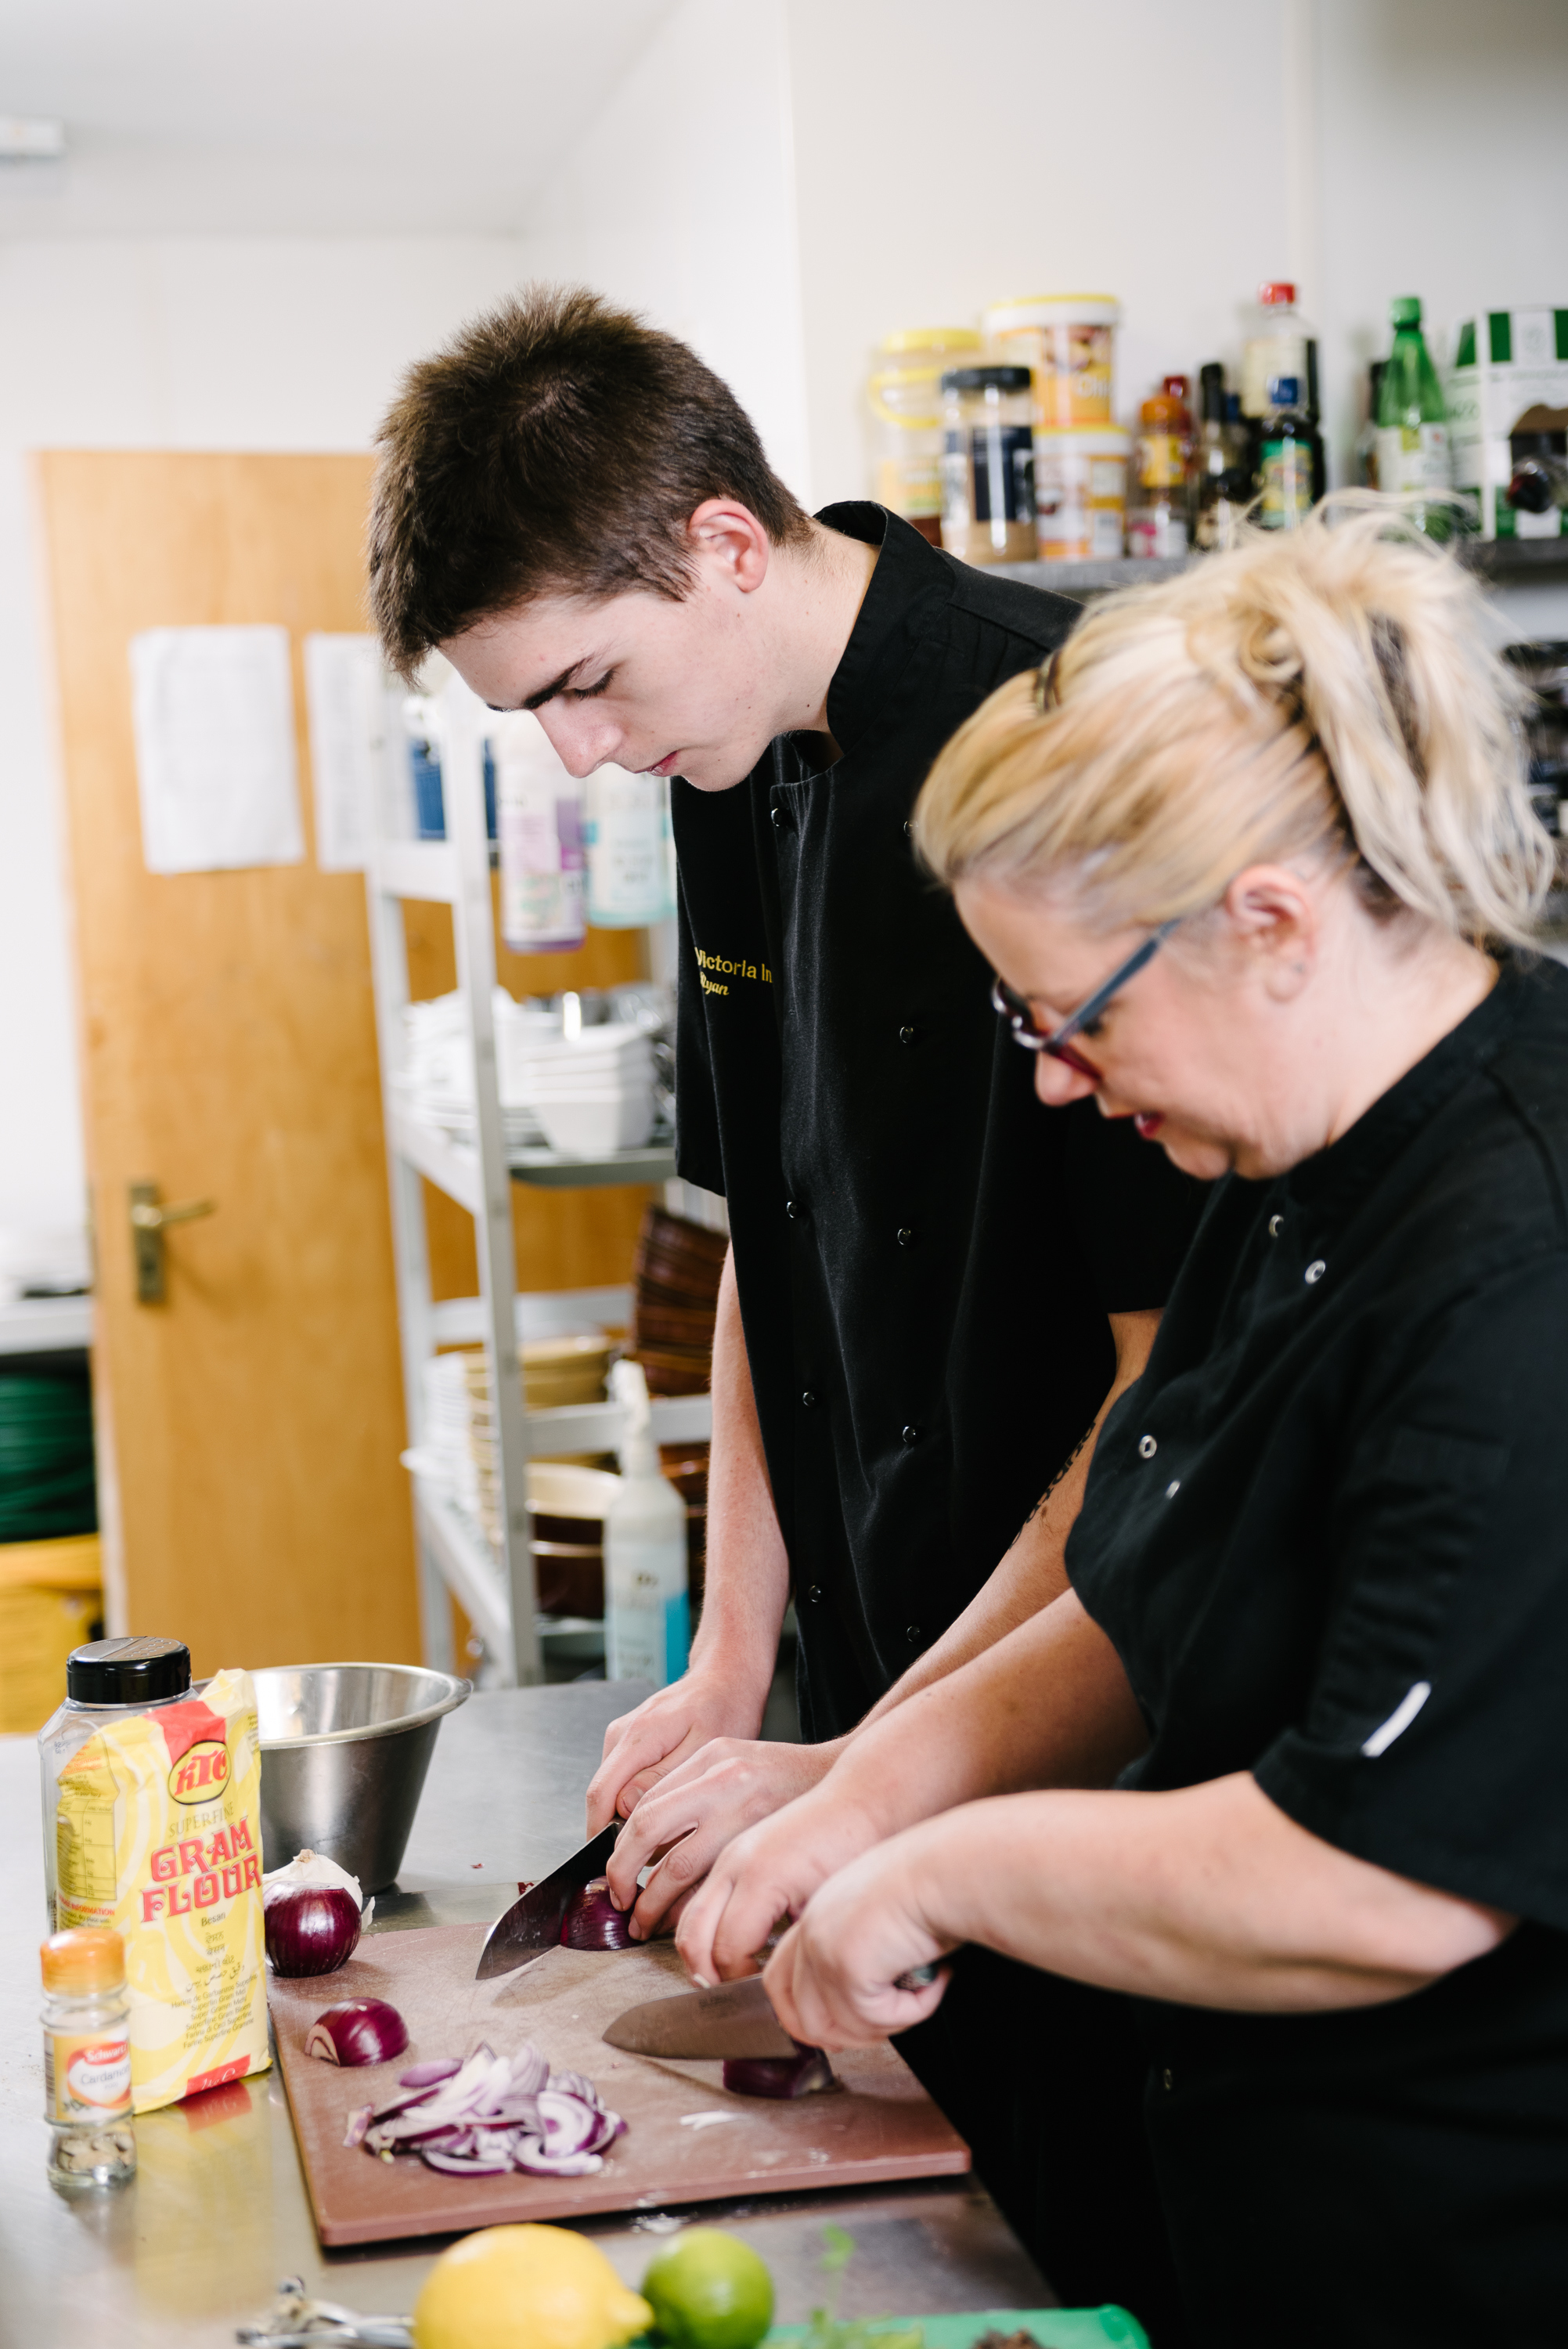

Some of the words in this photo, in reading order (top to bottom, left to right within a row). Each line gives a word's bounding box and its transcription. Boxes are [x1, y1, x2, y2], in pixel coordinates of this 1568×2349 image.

[694, 947, 757, 979] Victoria
[174, 1748, 228, 1796] KTC
[168, 1802, 234, 1838] SUPERFINE
[150, 1816, 254, 1882] GRAM
[140, 1852, 262, 1923] FLOUR
[201, 1912, 226, 1927] Besan
[218, 1993, 234, 2002] Gram
[191, 2010, 209, 2020] Super
[218, 2009, 233, 2019] Gram
[204, 2028, 231, 2041] Superfine
